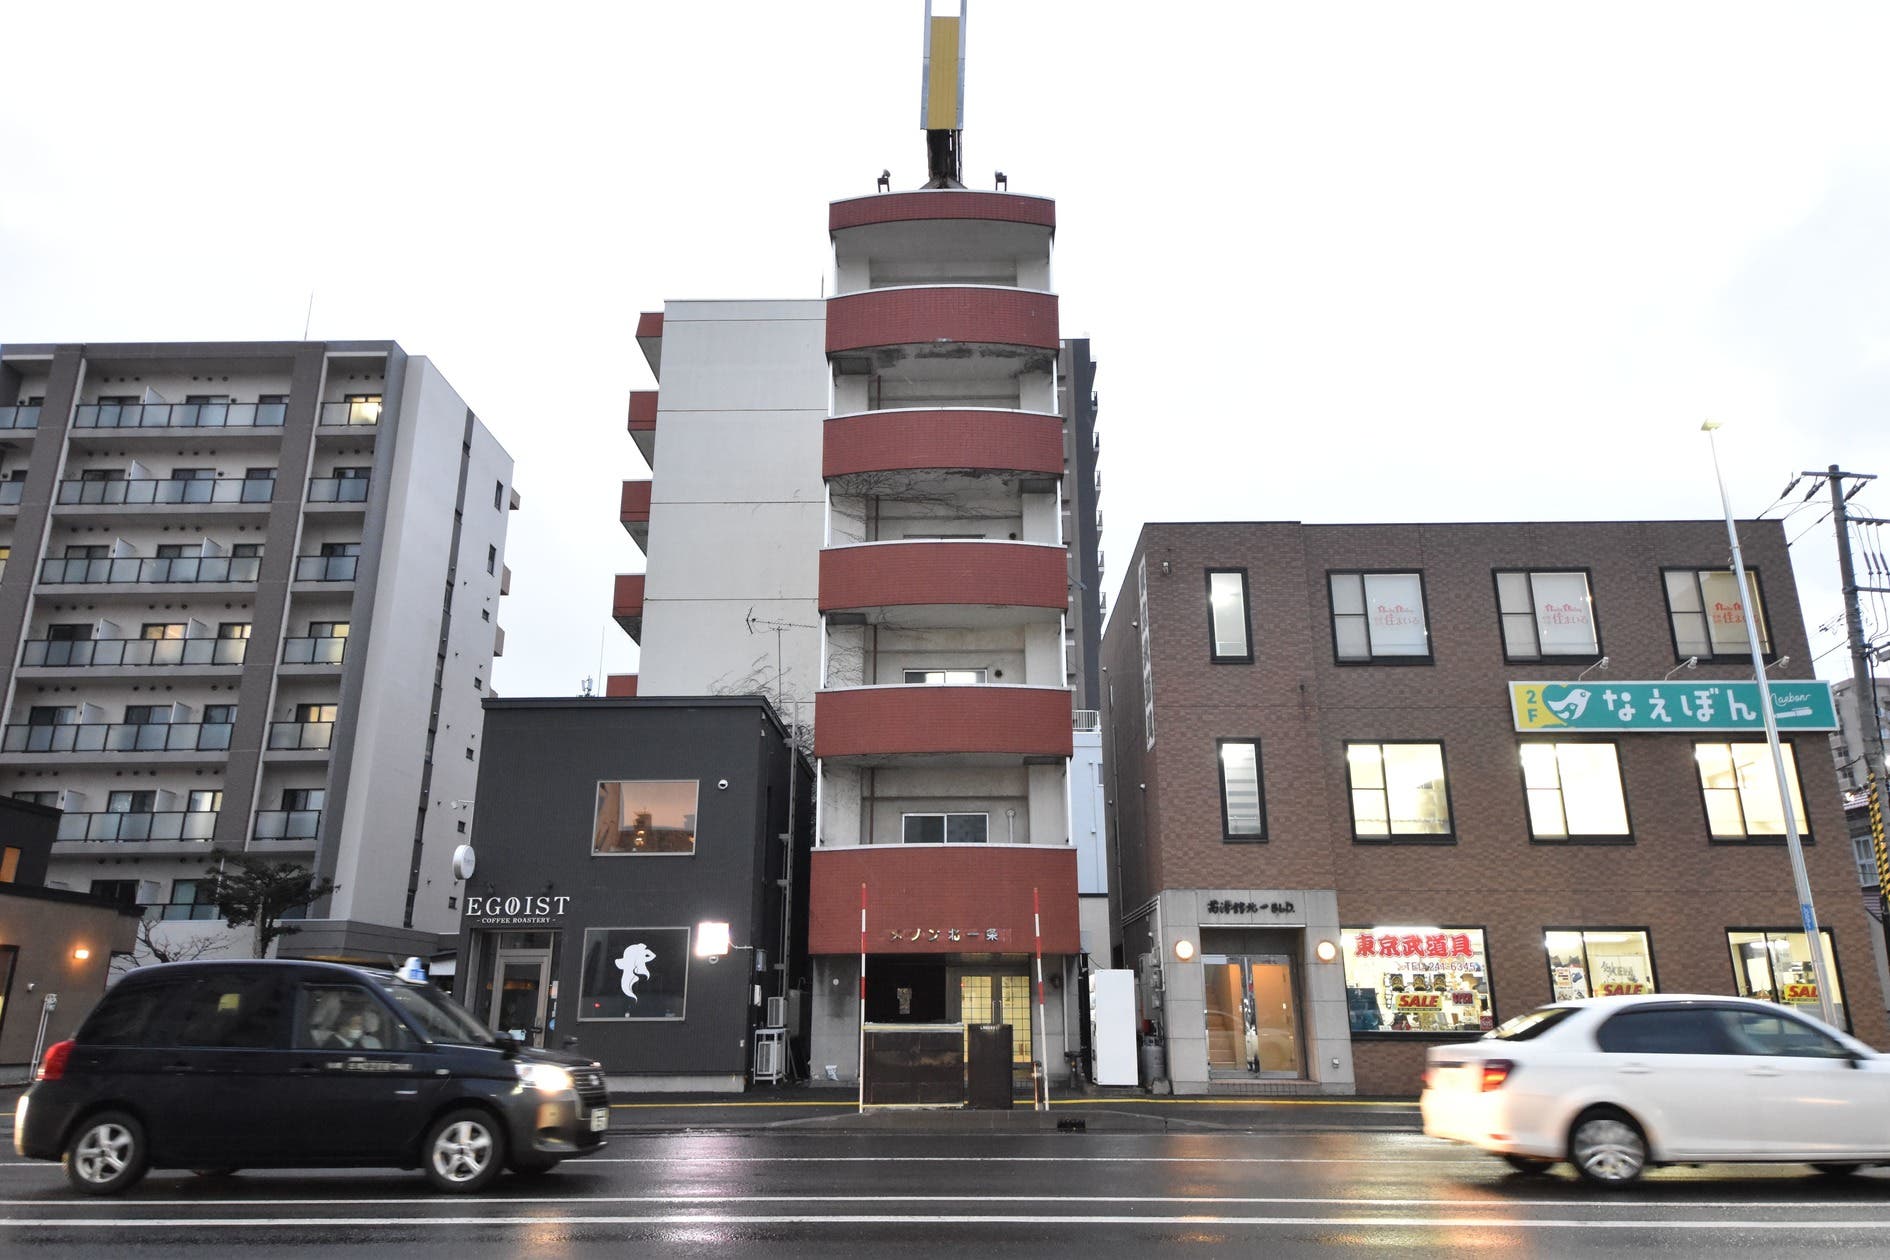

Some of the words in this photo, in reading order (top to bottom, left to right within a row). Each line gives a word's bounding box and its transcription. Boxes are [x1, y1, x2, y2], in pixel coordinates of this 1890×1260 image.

[1602, 687, 1757, 723] なえぼん
[465, 896, 571, 916] EGOIST
[1355, 933, 1473, 957] 東京武道具
[1604, 984, 1644, 996] SALE
[1398, 994, 1440, 1007] SALE
